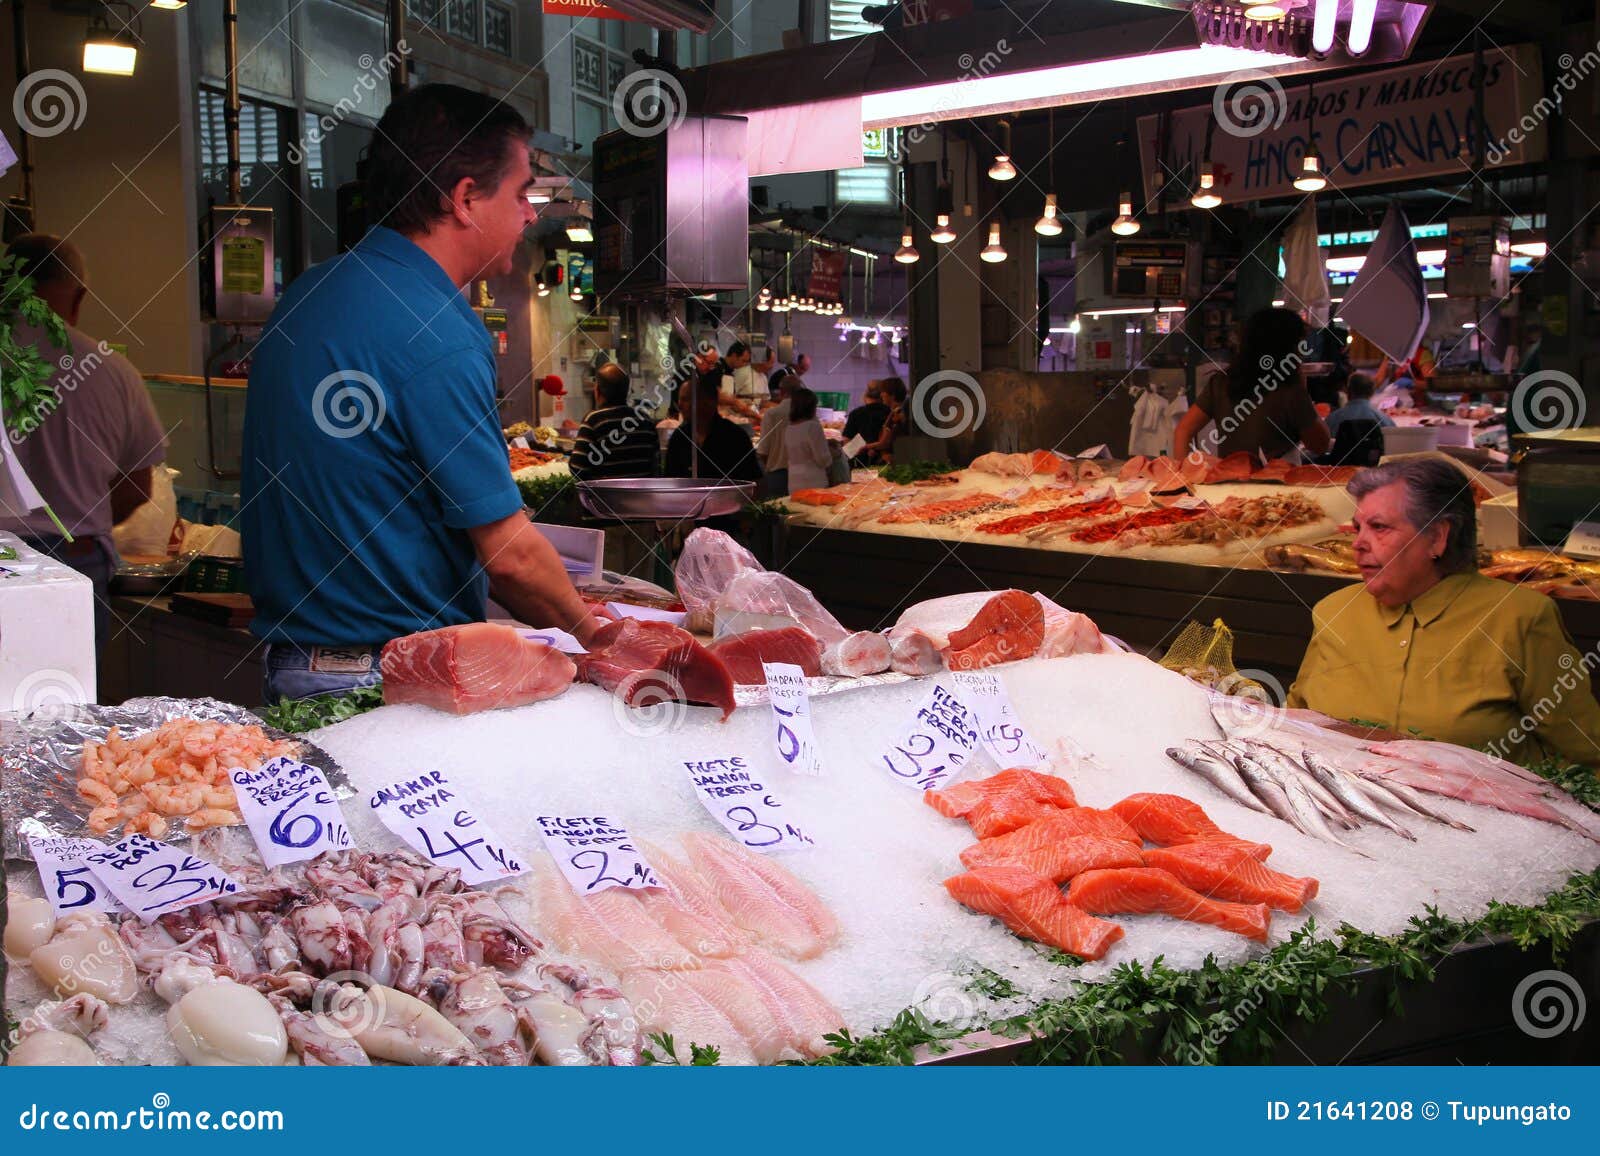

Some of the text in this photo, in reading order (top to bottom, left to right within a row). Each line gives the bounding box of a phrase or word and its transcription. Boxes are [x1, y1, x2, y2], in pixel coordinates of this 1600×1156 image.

[1354, 84, 1371, 110] Y
[1336, 105, 1509, 175] CARVAJA
[269, 792, 323, 848] 6
[417, 827, 485, 871] 4
[570, 850, 634, 890] 2
[55, 866, 97, 909] 5
